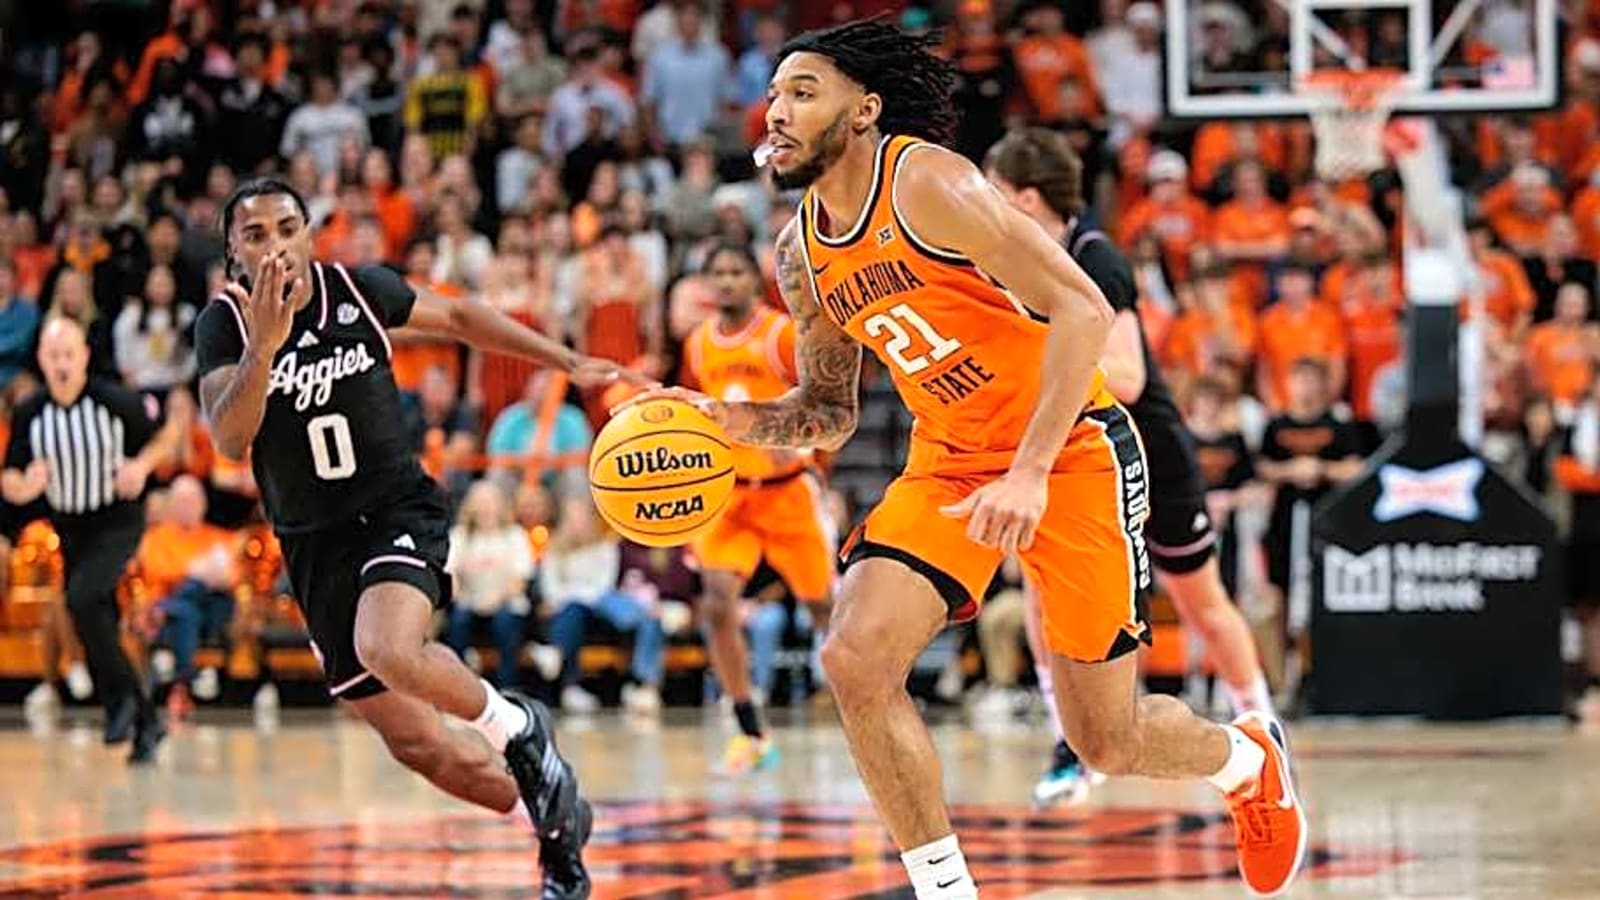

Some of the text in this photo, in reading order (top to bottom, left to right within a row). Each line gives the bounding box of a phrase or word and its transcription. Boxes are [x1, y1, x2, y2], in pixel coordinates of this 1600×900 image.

[827, 259, 926, 326] OKLAHOMA
[863, 303, 962, 375] 21
[267, 343, 376, 411] Aggies
[921, 356, 995, 405] STATE
[307, 413, 357, 480] 0
[616, 447, 713, 478] Wilson
[636, 494, 703, 520] NCAA
